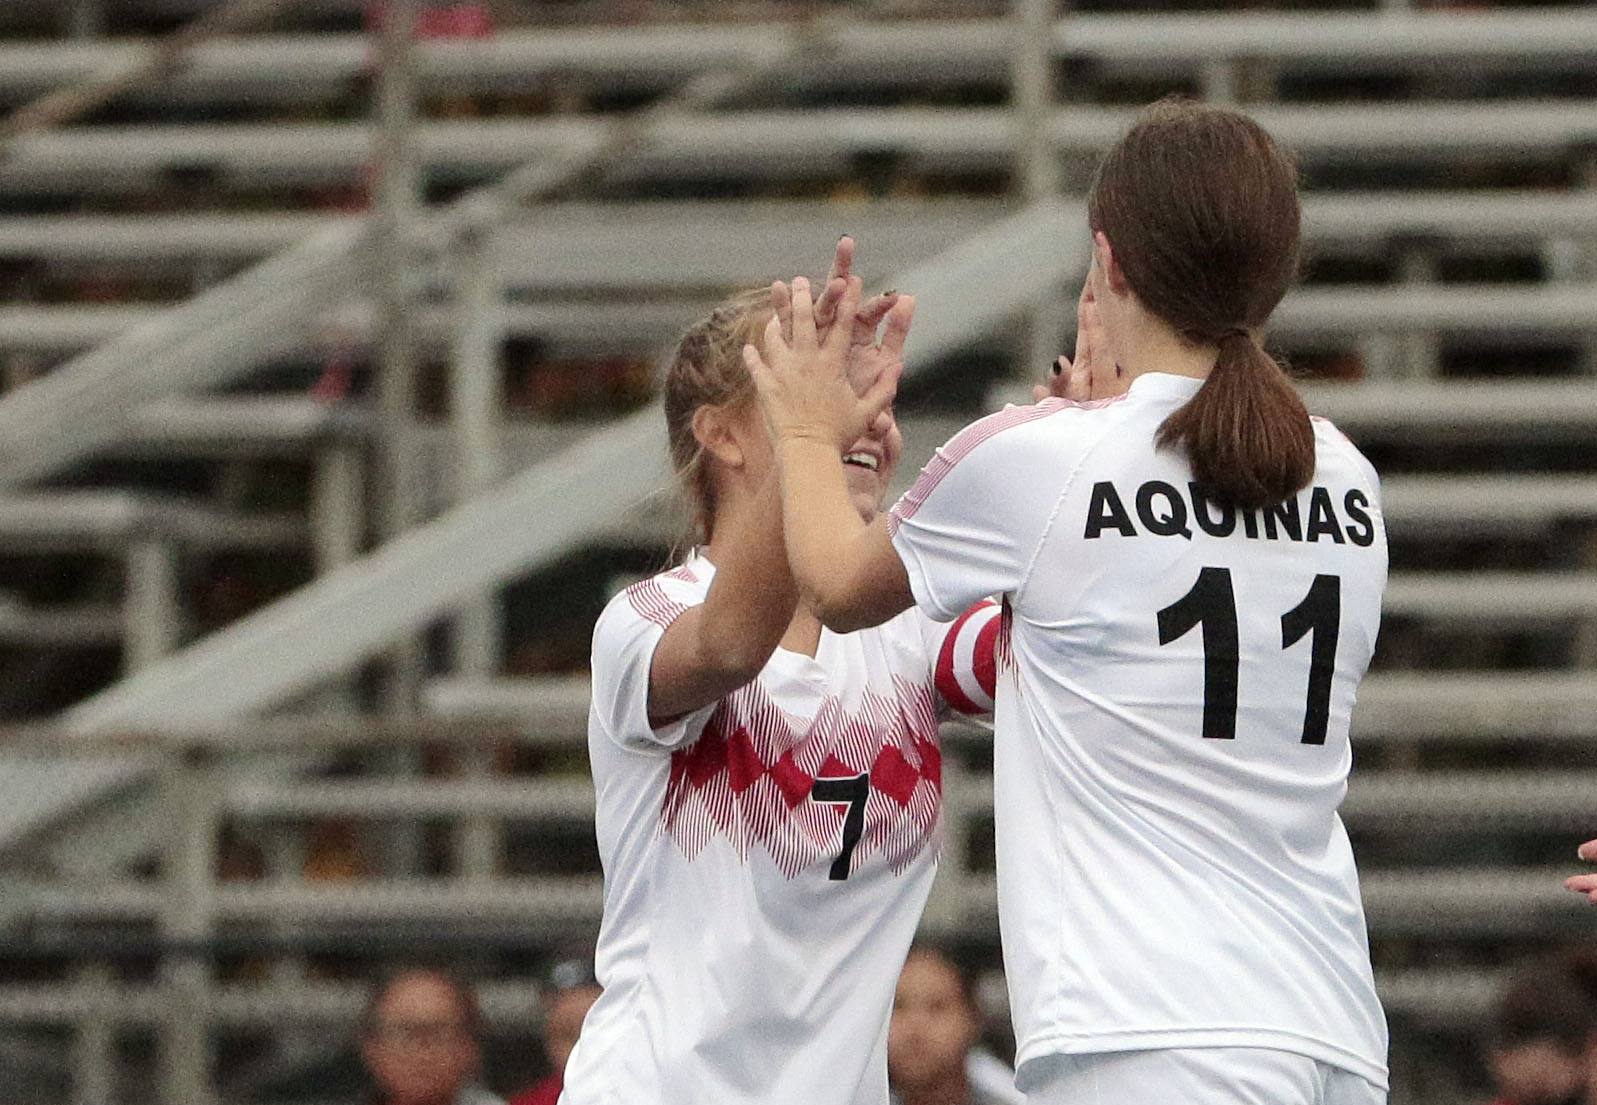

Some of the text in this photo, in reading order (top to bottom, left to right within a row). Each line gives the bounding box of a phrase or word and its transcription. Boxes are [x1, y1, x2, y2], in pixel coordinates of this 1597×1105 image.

[1084, 480, 1375, 547] AQUINAS
[1157, 566, 1341, 745] 11
[811, 772, 869, 880] 7
